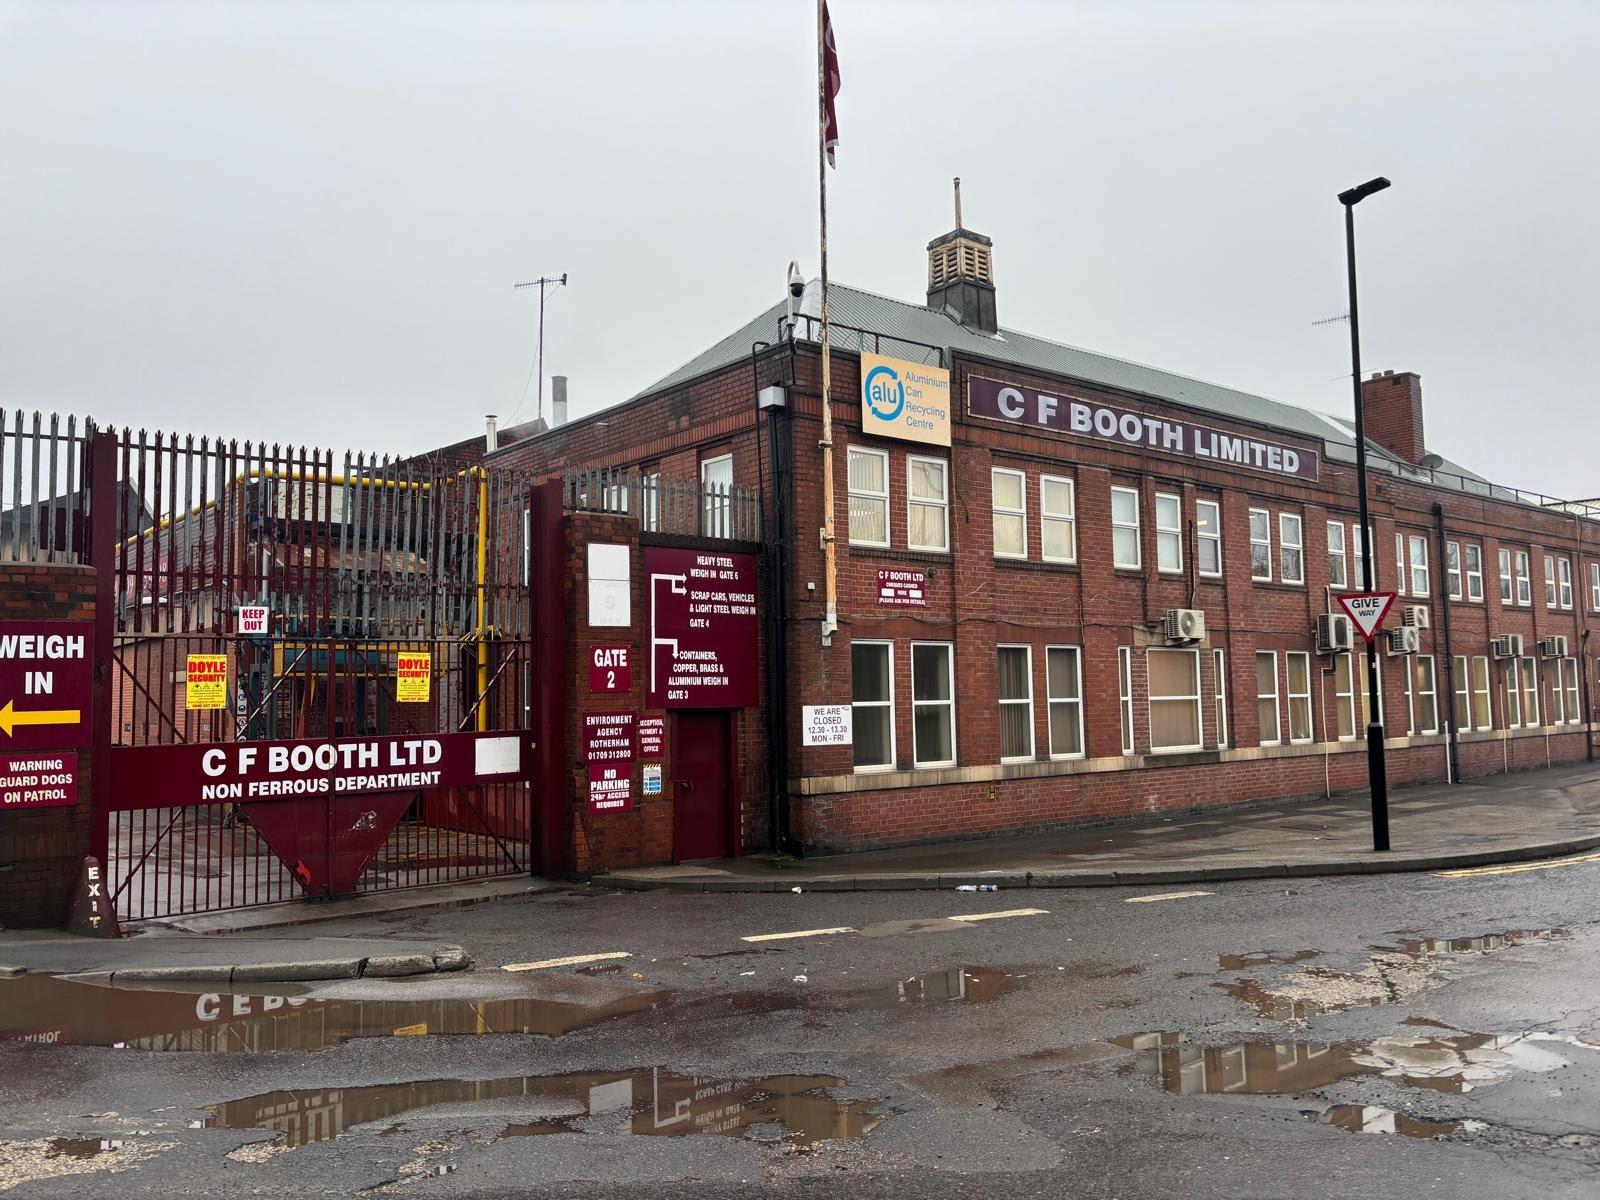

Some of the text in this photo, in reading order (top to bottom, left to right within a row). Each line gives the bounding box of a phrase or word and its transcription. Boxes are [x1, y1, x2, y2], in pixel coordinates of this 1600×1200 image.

[905, 371, 948, 389] Aluminium
[872, 381, 897, 404] alu
[905, 386, 923, 398] Can
[905, 402, 946, 420] Recycling
[906, 416, 934, 430] Centre
[997, 386, 1300, 474] C F BOOTH LIMITED
[696, 555, 734, 568] HEAVY STEEL
[690, 568, 739, 580] WEIGH IN GATE 6
[878, 570, 924, 582] C F BOOTH LTD
[690, 590, 755, 603] SCRAP CARS, VEHICLES
[1351, 598, 1380, 609] GIVE
[242, 609, 265, 619] KEEP
[689, 604, 756, 615] & LIGHT STEEL WEIGH IN
[1358, 609, 1376, 617] WAY
[243, 620, 263, 631] OUT
[689, 618, 710, 628] GATE 4
[0, 635, 85, 659] WEIGH
[594, 649, 627, 667] GATE
[679, 651, 718, 662] CONTAINERS,
[188, 661, 226, 673] DOYLE
[399, 658, 430, 670] DOYLE
[672, 663, 724, 674] COPPER, BRASS &
[188, 674, 225, 682] SECURITY
[398, 670, 429, 678] SECURITY
[607, 670, 615, 688] 2
[25, 672, 53, 695] IN
[667, 676, 729, 686] ALUMINIUM WEIGH IN
[667, 690, 689, 700] GATE 3
[586, 715, 633, 726] ENVIRONMENT
[813, 716, 842, 725] CLOSED
[596, 727, 623, 737] AGENCY
[808, 726, 826, 734] 12.30
[831, 725, 848, 733] 13.30
[590, 738, 630, 749] ROTHERHAM
[812, 735, 828, 743] MON
[833, 734, 845, 742] FRI
[643, 745, 659, 753] OFFICE
[202, 739, 442, 777] C F BOOTH LTD
[588, 750, 631, 760] 01709 312800
[9, 759, 63, 772] WARNING
[604, 769, 617, 780] NO
[0, 773, 73, 788] GUARD DOGS
[202, 770, 442, 800] NON FERROUS DEPARTMENT
[590, 779, 630, 791] PARKING
[3, 788, 67, 804] ON PATROL
[590, 791, 630, 802] 24hr ACCESS
[596, 800, 624, 809] REQUIRED
[87, 866, 101, 929] EXIT
